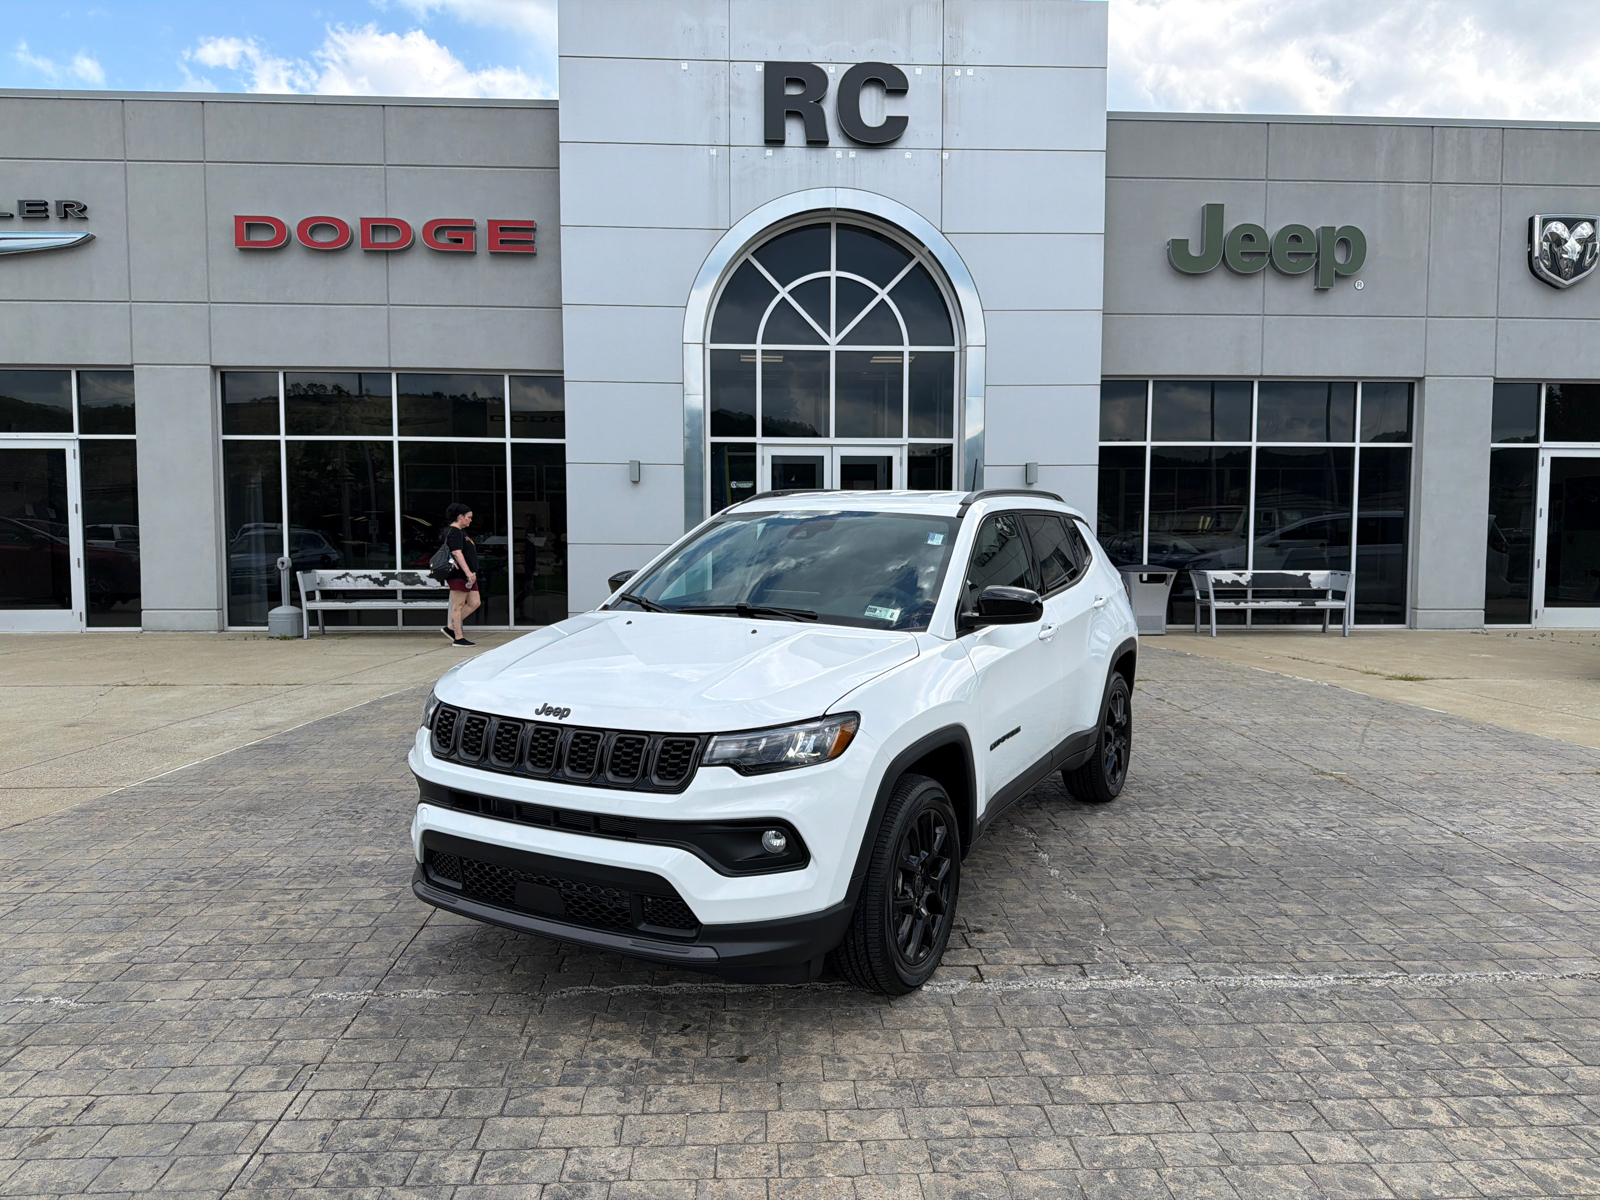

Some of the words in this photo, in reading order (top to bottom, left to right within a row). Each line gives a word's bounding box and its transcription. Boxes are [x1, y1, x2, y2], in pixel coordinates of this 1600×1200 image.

[764, 61, 910, 146] RC
[233, 215, 537, 255] DODGE
[1167, 203, 1367, 290] Jeep
[534, 702, 571, 720] Jeep
